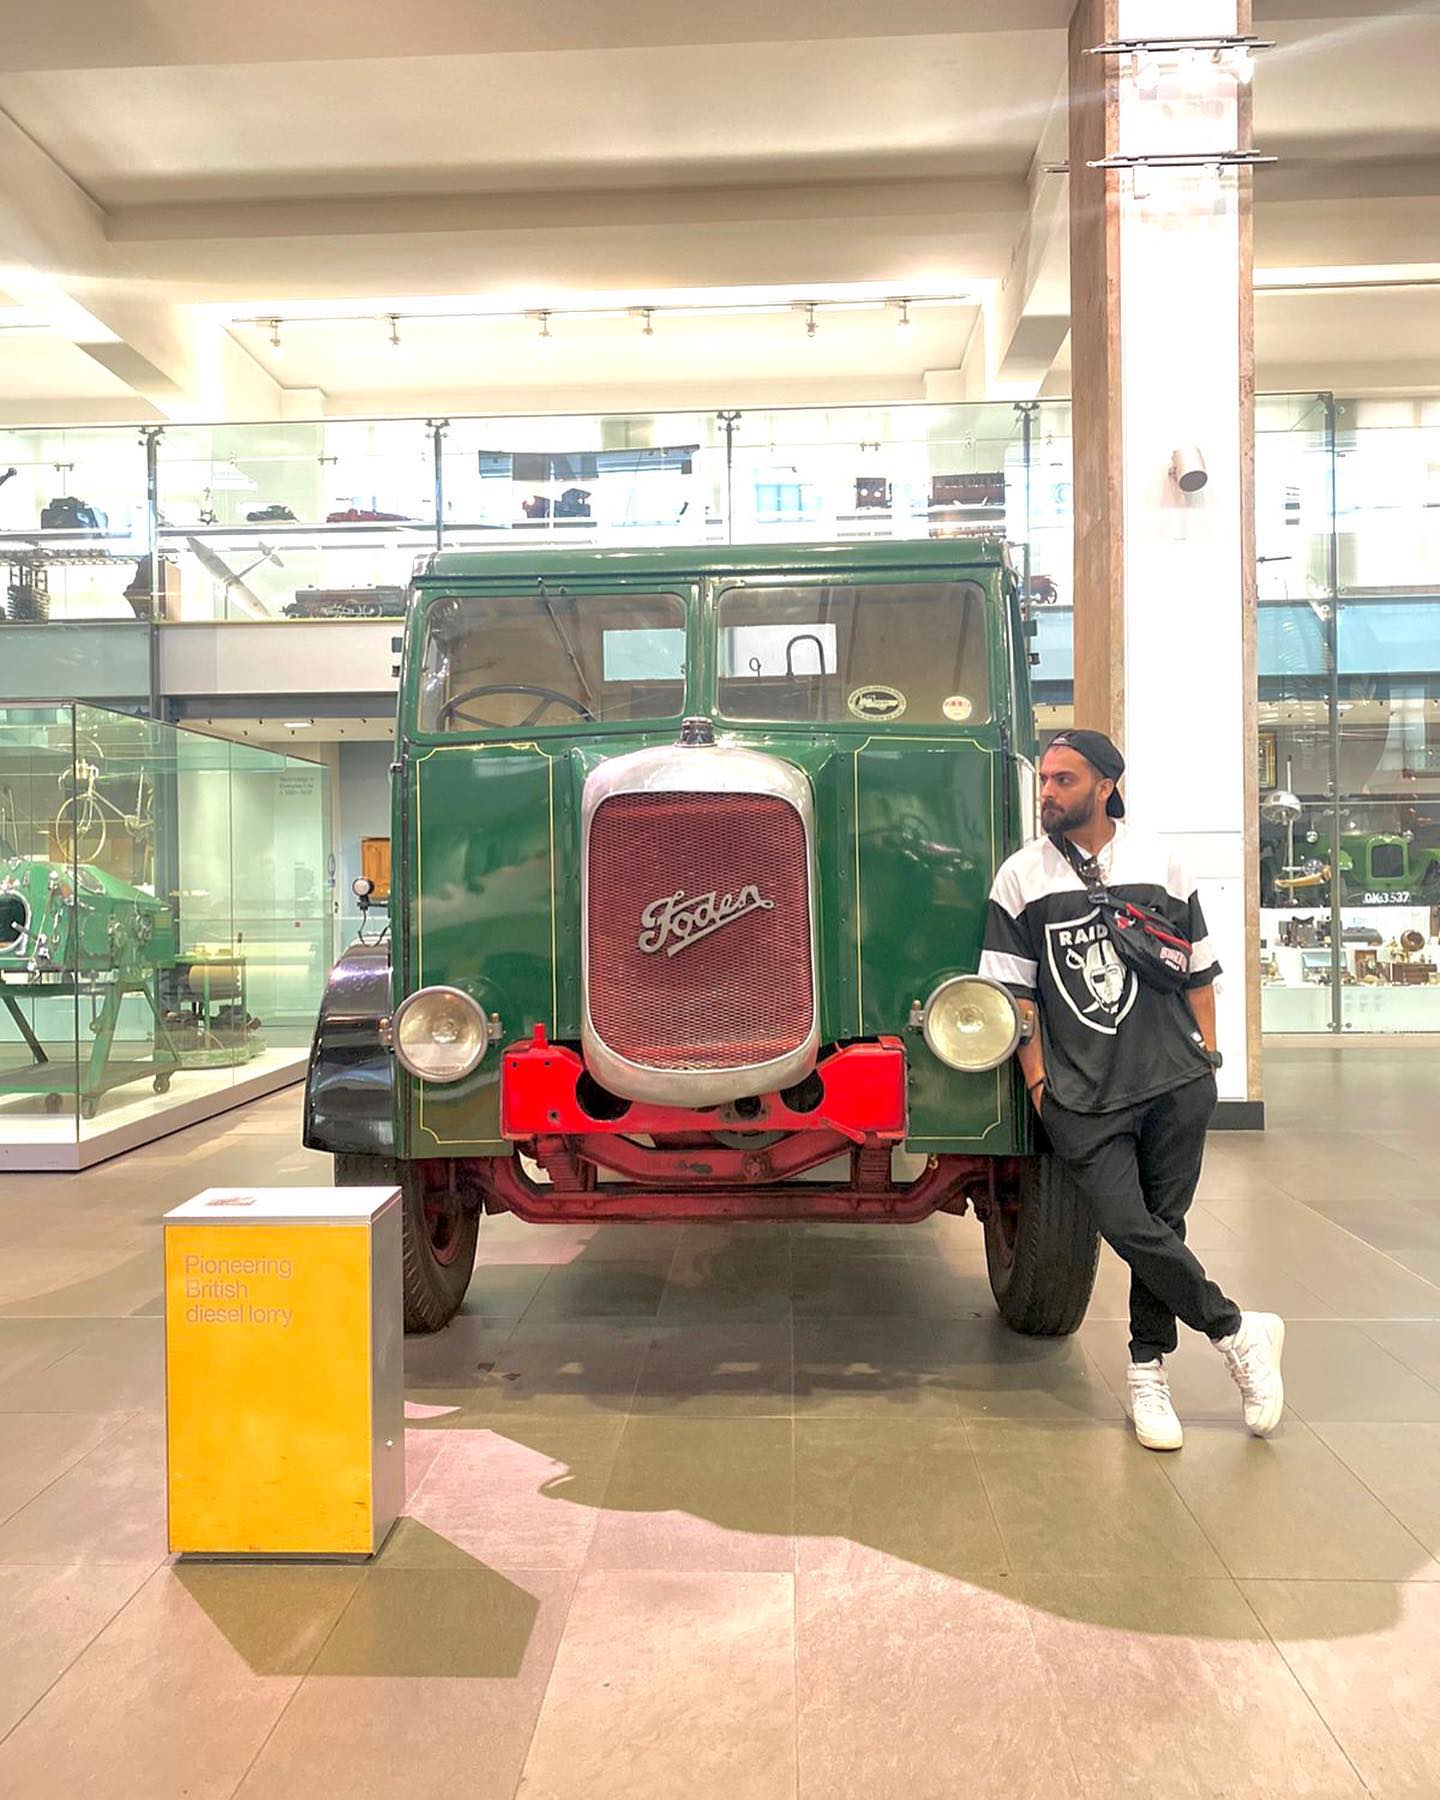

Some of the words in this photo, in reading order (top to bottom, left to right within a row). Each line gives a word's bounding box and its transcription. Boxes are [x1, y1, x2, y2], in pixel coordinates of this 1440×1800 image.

[637, 884, 775, 958] Foden
[185, 1255, 292, 1279] Pioneering
[185, 1280, 248, 1298] British
[185, 1304, 243, 1324] diesel
[249, 1304, 293, 1328] lorry
